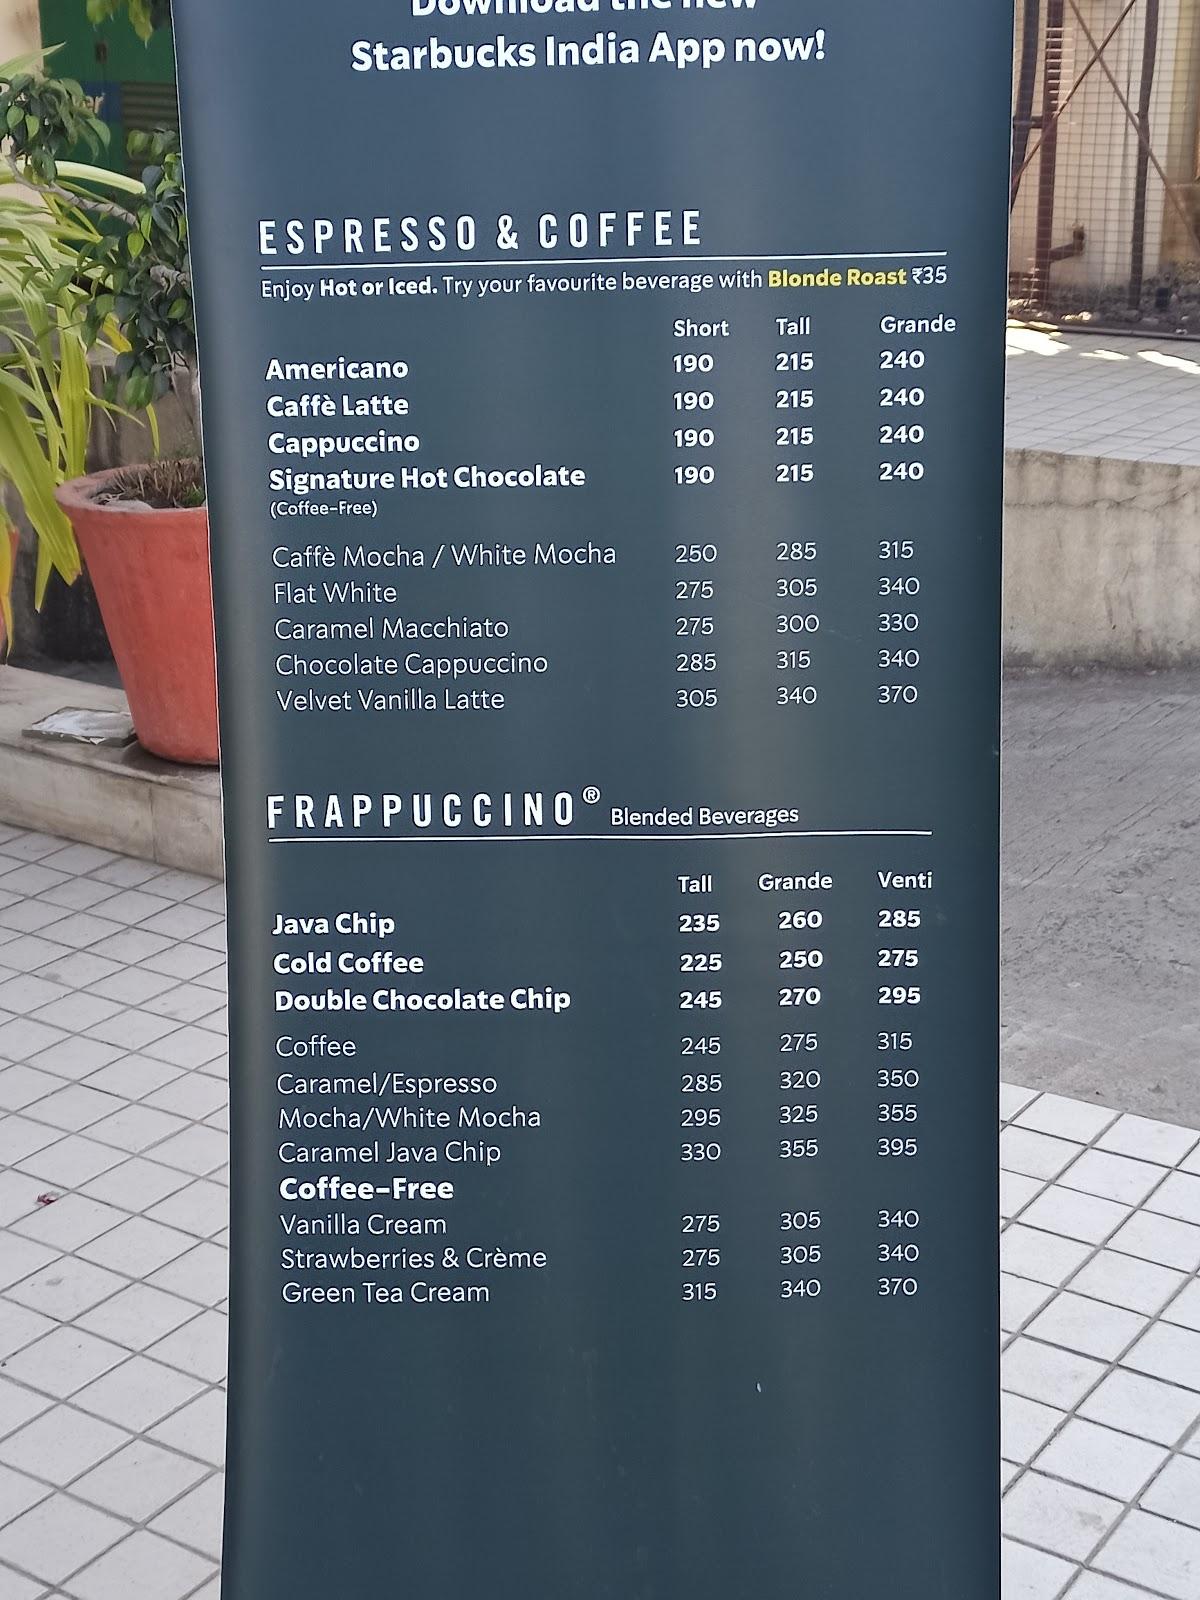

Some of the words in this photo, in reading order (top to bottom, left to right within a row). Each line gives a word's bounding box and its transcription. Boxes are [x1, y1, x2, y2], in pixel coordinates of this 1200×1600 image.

[351, 35, 536, 72] Starbucks
[546, 31, 640, 66] India
[648, 31, 726, 69] App
[735, 29, 825, 62] now!
[259, 215, 476, 255] ESPRESSO
[496, 214, 519, 250] &
[539, 210, 701, 249] COFFEE
[261, 279, 315, 302] Enjoy
[320, 278, 358, 297] Hot
[361, 281, 384, 296] or
[388, 275, 438, 296] Iced.
[442, 276, 473, 298] Try
[478, 279, 523, 298] your
[526, 272, 617, 293] favourite
[622, 271, 714, 293] beverage
[718, 269, 763, 289] with
[768, 268, 843, 288] Blonde
[847, 268, 908, 286] Roast
[911, 265, 947, 285] ₹35
[673, 318, 730, 338] Short
[775, 316, 810, 336] Tall
[880, 313, 956, 334] Grande
[265, 356, 409, 380] Americano
[673, 354, 714, 373] 190
[776, 352, 814, 371] 215
[880, 350, 925, 369] 240
[267, 394, 337, 417] Caffè
[342, 395, 409, 416] Latte
[673, 391, 715, 410] 190
[776, 389, 814, 409] 215
[879, 387, 925, 407] 240
[268, 429, 420, 458] Cappuccino
[674, 428, 715, 448] 190
[776, 426, 814, 446] 215
[879, 424, 925, 444] 240
[269, 467, 395, 495] Signature
[401, 467, 448, 489] Hot
[453, 464, 586, 488] Chocolate
[674, 465, 715, 485] 190
[776, 463, 814, 482] 215
[879, 462, 924, 481] 240
[270, 500, 378, 520] (Coffee-Free)
[272, 545, 336, 568] Caffè
[343, 544, 424, 567] Mocha
[431, 544, 446, 569] /
[450, 543, 526, 566] White
[534, 541, 616, 565] Mocha
[675, 544, 718, 563] 250
[776, 542, 817, 561] 285
[878, 540, 914, 559] 315
[274, 581, 317, 604] Flat
[322, 580, 397, 603] White
[676, 580, 714, 600] 275
[776, 578, 818, 597] 305
[878, 577, 920, 596] 340
[275, 616, 374, 640] Caramel
[382, 616, 509, 639] Macchiato
[676, 616, 714, 636] 275
[776, 614, 820, 633] 300
[878, 613, 919, 632] 330
[276, 652, 398, 676] Chocolate
[405, 652, 548, 680] Cappuccino
[676, 653, 717, 672] 285
[776, 650, 811, 669] 315
[878, 649, 920, 668] 340
[276, 688, 352, 711] Velvet
[357, 687, 437, 711] Vanilla
[445, 688, 505, 710] Latte
[676, 688, 718, 708] 305
[777, 686, 818, 705] 340
[877, 685, 918, 704] 370
[611, 807, 693, 826] Blended
[699, 807, 799, 828] Beverages
[677, 874, 712, 893] Tall
[758, 871, 833, 891] Grande
[877, 871, 933, 889] Venti
[272, 914, 329, 935] Java
[335, 912, 395, 939] Chip
[679, 914, 720, 932] 235
[778, 910, 823, 929] 260
[878, 909, 921, 928] 285
[273, 951, 332, 974] Cold
[338, 951, 424, 973] Coffee
[680, 953, 723, 972] 225
[779, 950, 824, 969] 250
[878, 949, 919, 967] 275
[275, 988, 368, 1011] Double
[372, 988, 505, 1011] Chocolate
[510, 986, 571, 1013] Chip
[680, 990, 722, 1009] 245
[779, 987, 821, 1006] 270
[878, 986, 921, 1004] 295
[276, 1034, 357, 1057] Coffee
[681, 1036, 721, 1055] 245
[780, 1033, 818, 1052] 275
[877, 1032, 913, 1050] 315
[277, 1071, 498, 1099] Caramel/Espresso
[681, 1074, 723, 1093] 285
[780, 1070, 821, 1089] 320
[877, 1069, 920, 1088] 350
[279, 1106, 451, 1131] Mocha/White
[458, 1105, 541, 1128] Mocha
[681, 1108, 721, 1127] 295
[779, 1104, 818, 1124] 325
[878, 1103, 918, 1122] 355
[278, 1140, 379, 1163] Caramel
[386, 1141, 438, 1163] Java
[445, 1140, 501, 1167] Chip
[681, 1142, 722, 1161] 330
[779, 1138, 819, 1158] 355
[878, 1138, 918, 1156] 395
[279, 1175, 454, 1200] Coffee-Free
[279, 1212, 360, 1235] Vanilla
[367, 1214, 447, 1235] Cream
[682, 1214, 720, 1233] 275
[780, 1211, 821, 1230] 305
[878, 1210, 920, 1228] 340
[281, 1247, 435, 1269] Strawberries
[442, 1247, 460, 1268] &
[466, 1247, 547, 1268] Crème
[682, 1248, 720, 1267] 275
[780, 1245, 821, 1264] 305
[878, 1244, 920, 1262] 340
[282, 1282, 355, 1303] Green
[362, 1282, 403, 1303] Tea
[410, 1281, 489, 1303] Cream
[682, 1282, 717, 1301] 315
[781, 1279, 821, 1298] 340
[878, 1277, 918, 1296] 370
